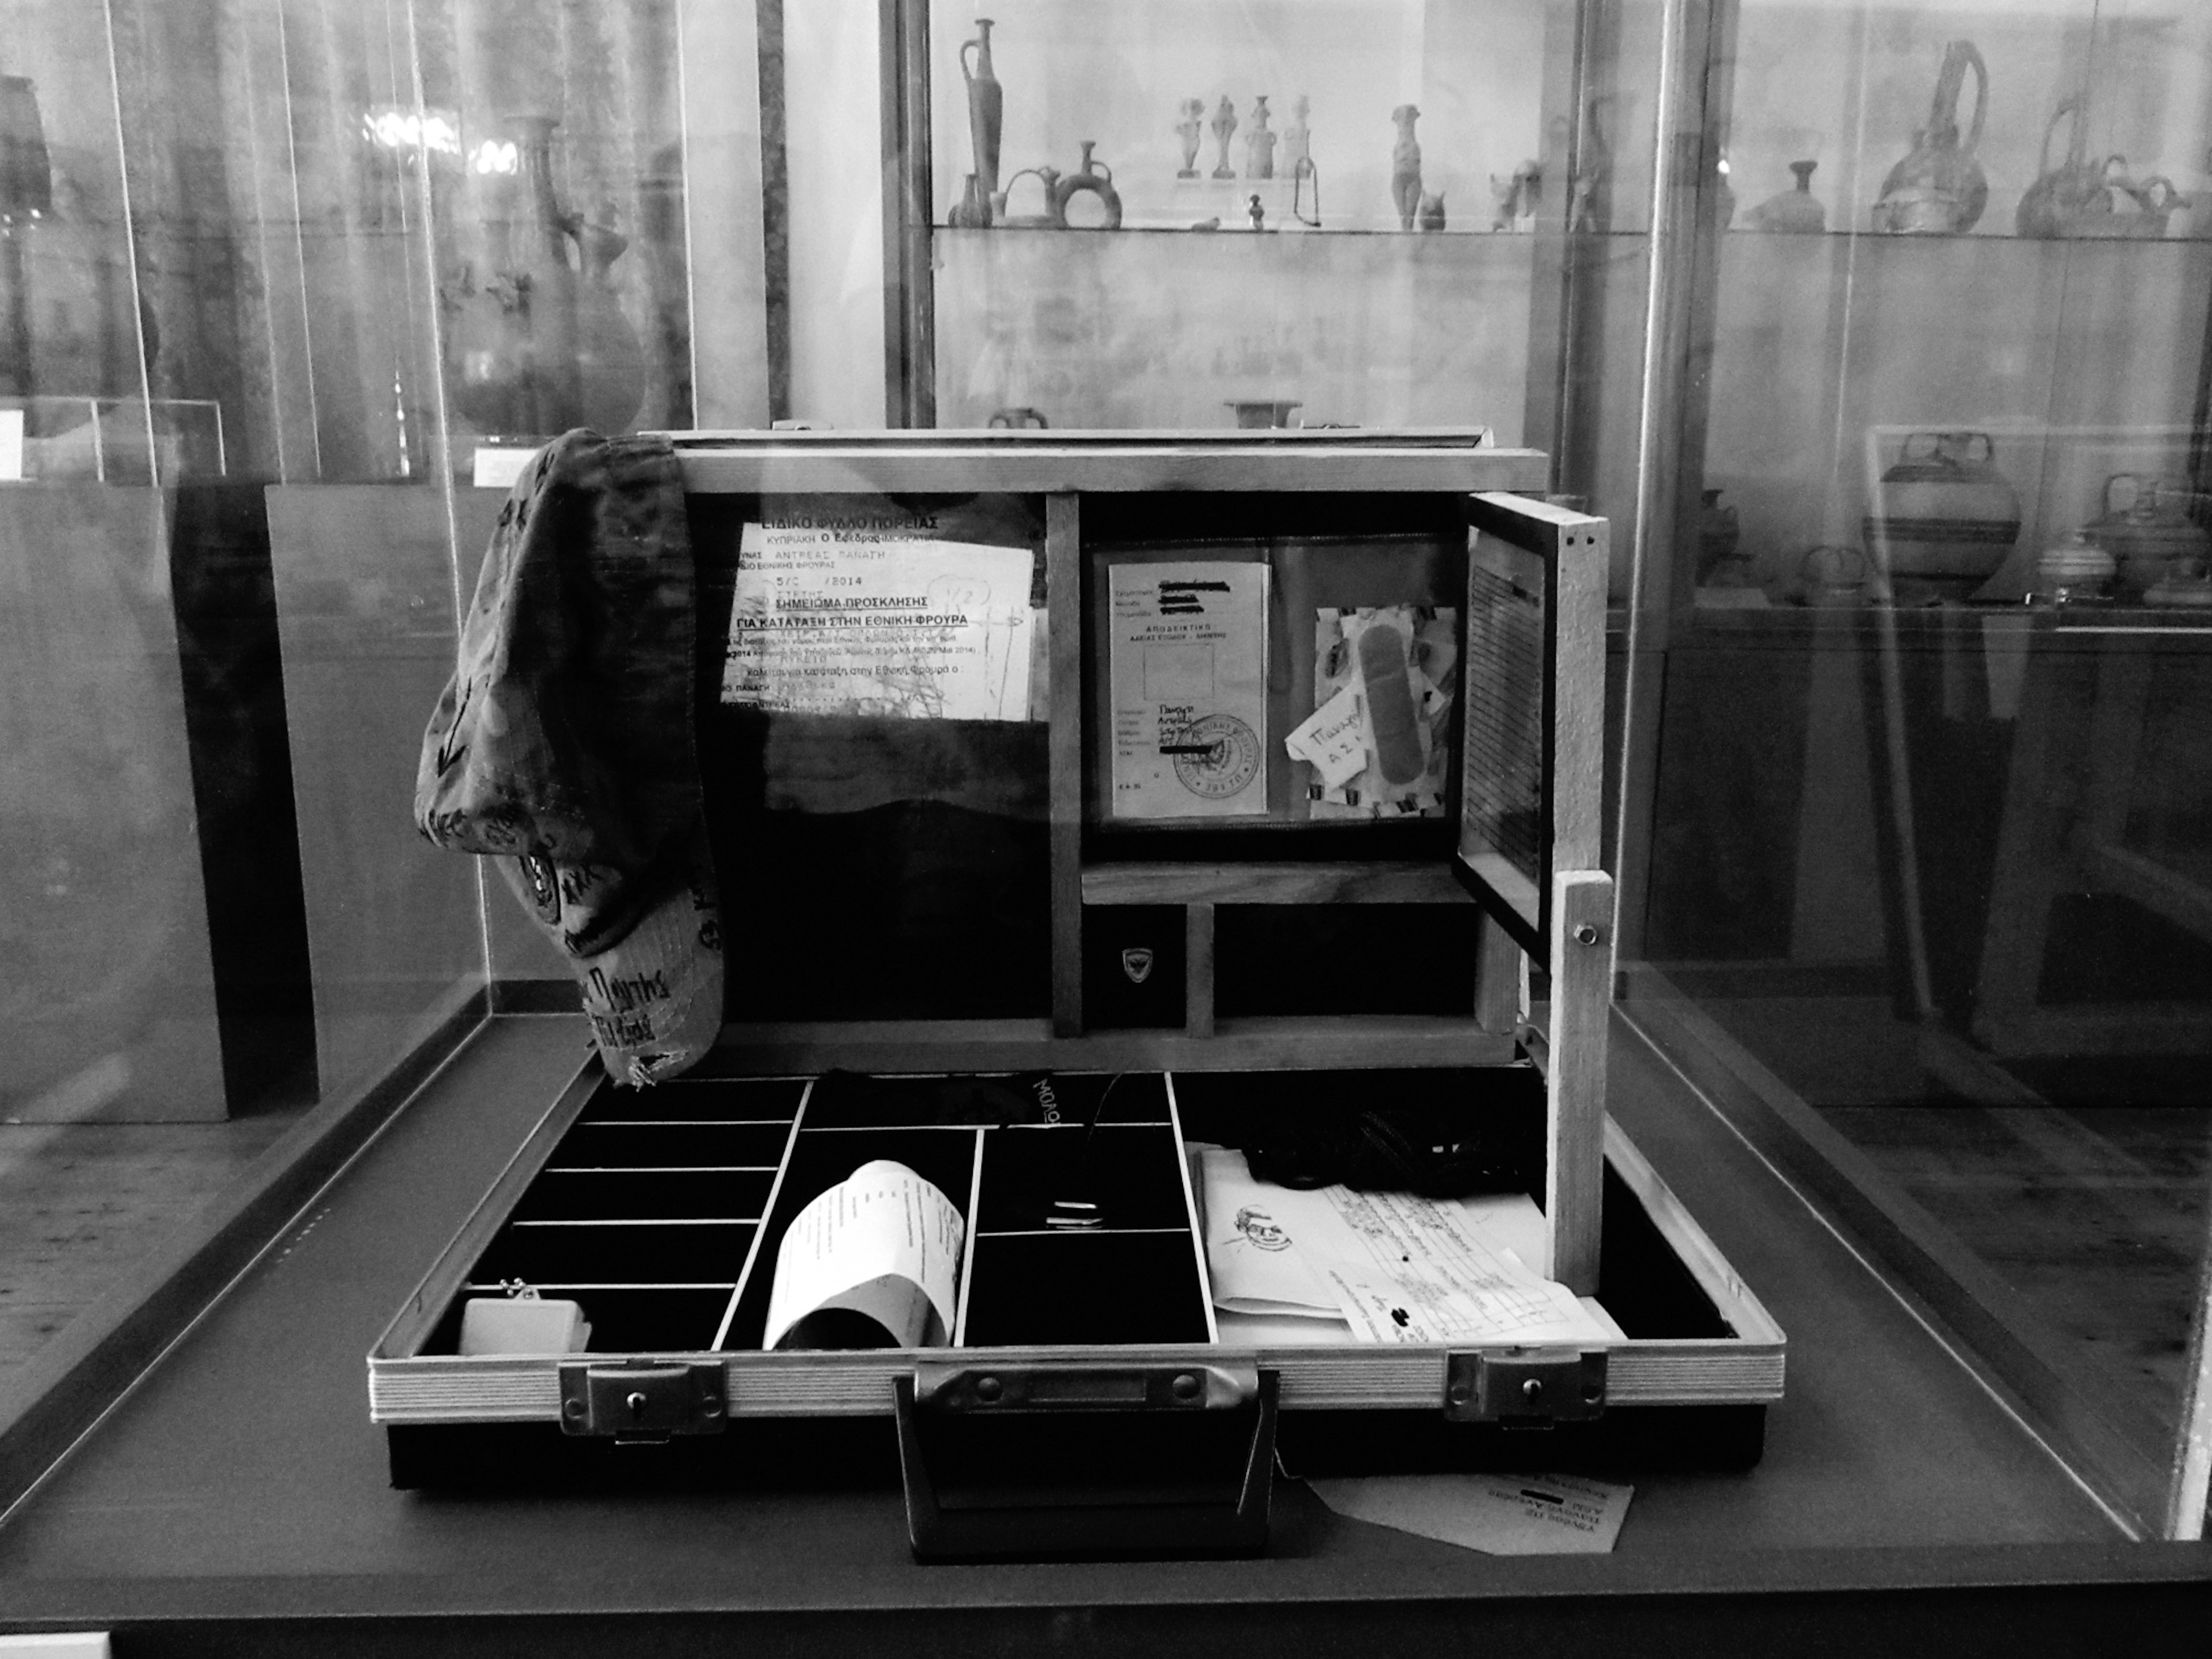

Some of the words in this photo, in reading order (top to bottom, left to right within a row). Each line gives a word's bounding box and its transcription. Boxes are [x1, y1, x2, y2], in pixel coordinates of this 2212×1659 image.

[872, 517, 939, 530] ΠΟΡΕΙΑΣ
[767, 535, 815, 545] ΚΥΠΡΙΑΚΗ
[776, 598, 841, 609] ΣΗΜΕΙΩΜΑ
[845, 596, 928, 608] ΠΡΟΣΚΛΗΣΗΣ
[736, 618, 757, 628] ΓΙΑ
[760, 618, 826, 627] ΚΑΤΑΤΑΞΗ
[830, 616, 862, 626] ΣΤΗΝ
[865, 615, 912, 625] ΕΘΝΙΚΗ
[915, 614, 968, 625] ΦΡΟΥΡΑ
[1146, 623, 1211, 633] ΑΠΟΔΕΙΚΤΙΚΟ
